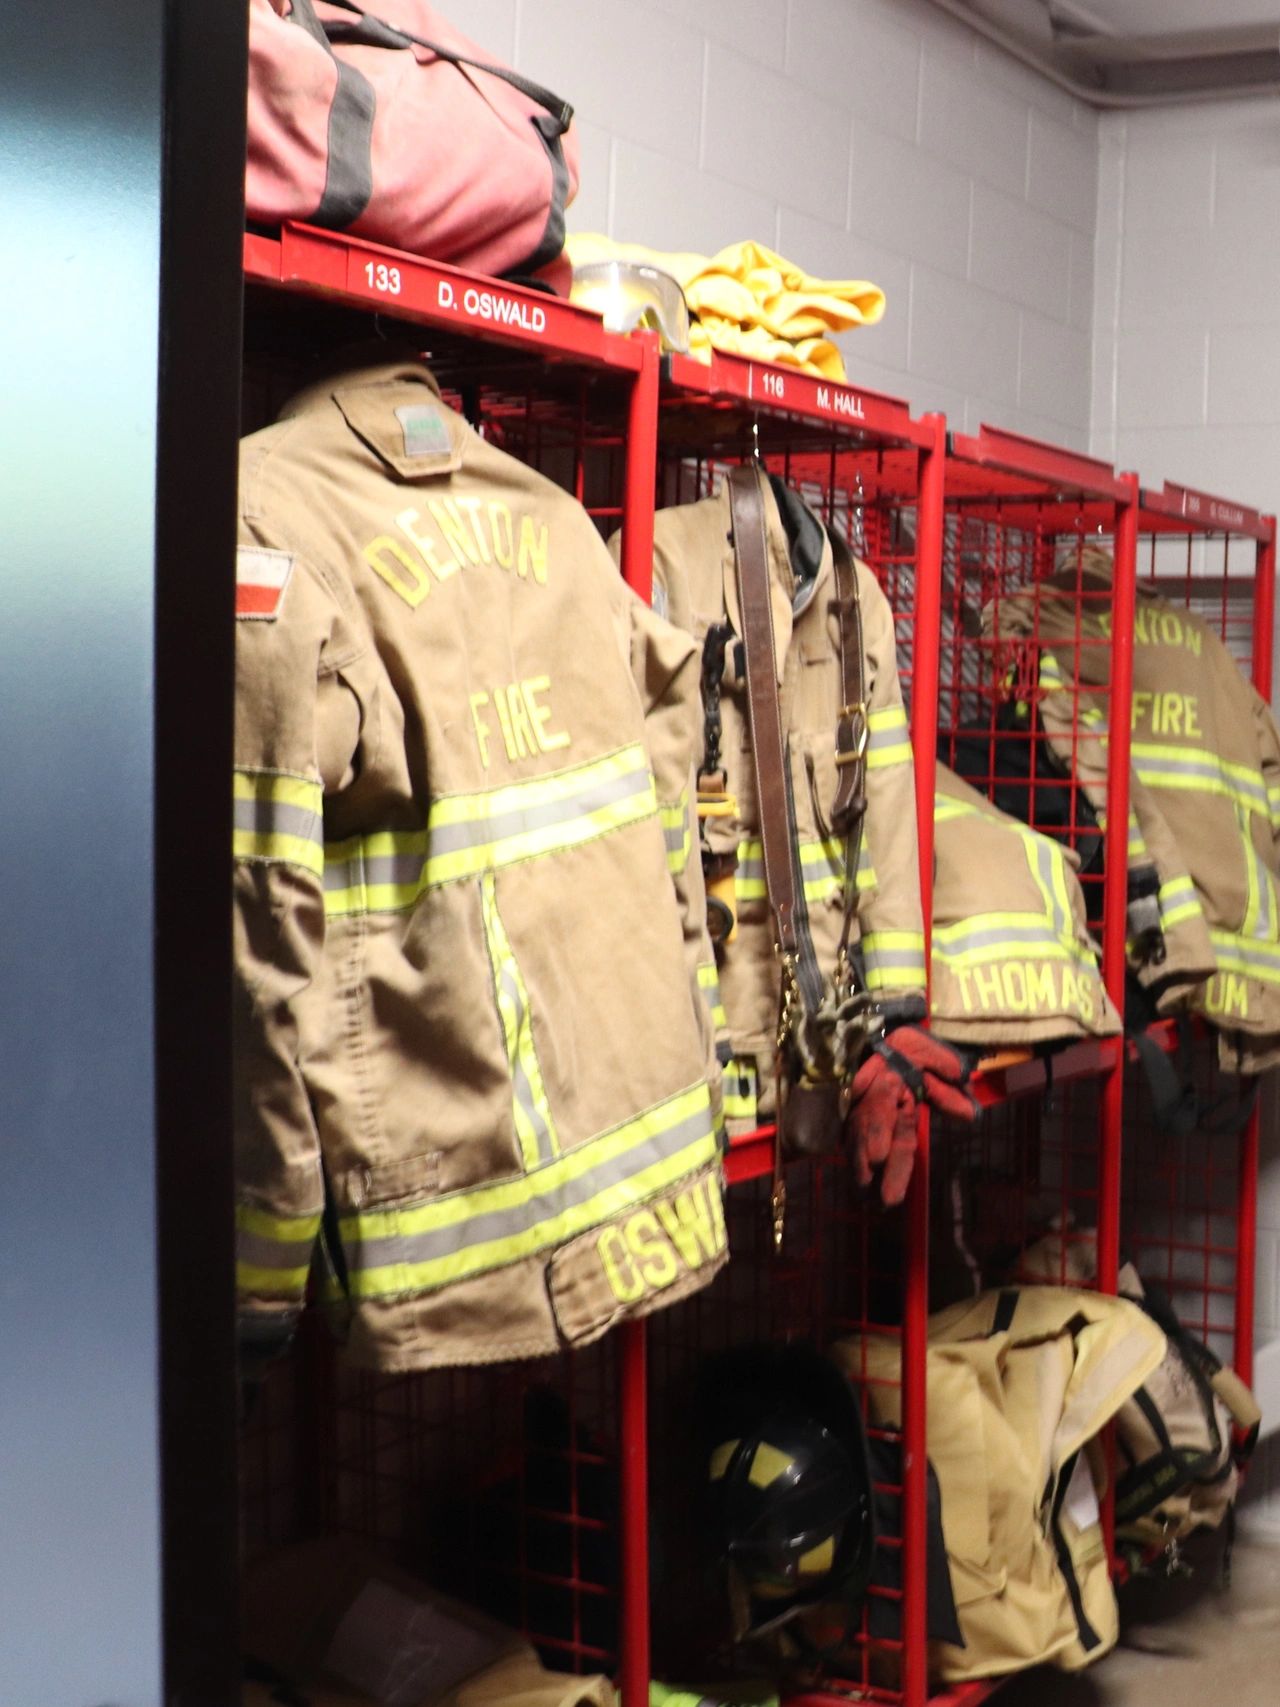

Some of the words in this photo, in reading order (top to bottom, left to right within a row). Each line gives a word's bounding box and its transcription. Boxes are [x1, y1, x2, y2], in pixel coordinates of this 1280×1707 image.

[365, 262, 401, 295] 133
[438, 281, 458, 312] D.
[463, 289, 546, 333] OSWALD
[763, 372, 785, 399] 116
[817, 386, 831, 411] M.
[834, 391, 865, 420] HALL
[363, 496, 549, 609] DENTON
[470, 675, 572, 769] FIRE
[1131, 692, 1203, 739] FIRE
[951, 960, 1094, 1022] THOMAS
